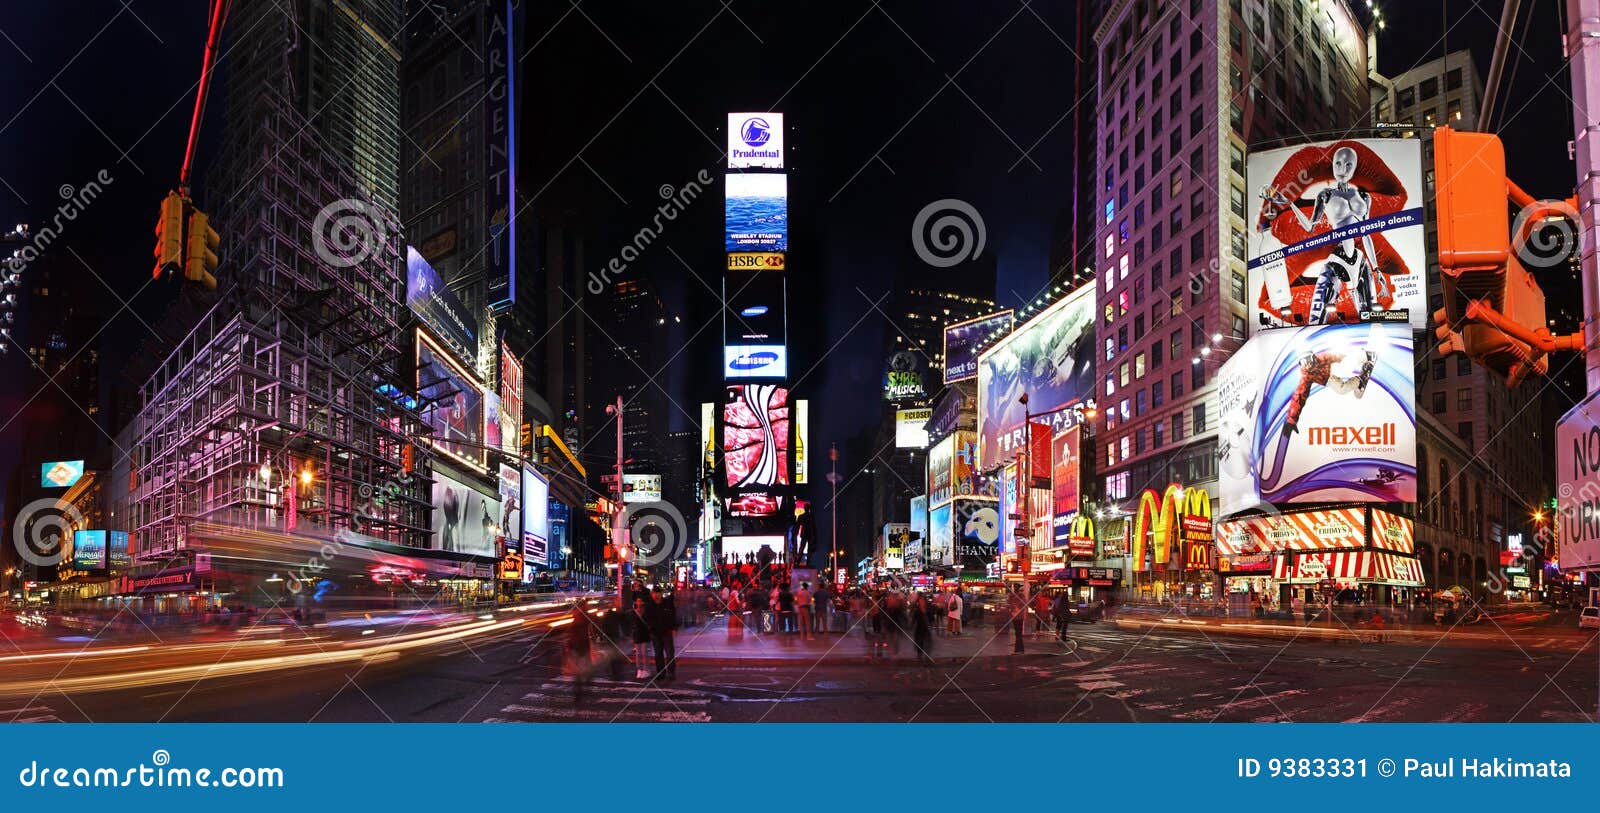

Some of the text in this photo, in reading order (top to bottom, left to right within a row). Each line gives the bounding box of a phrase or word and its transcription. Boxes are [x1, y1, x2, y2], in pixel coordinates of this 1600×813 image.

[733, 149, 780, 158] Prudential
[1288, 244, 1304, 254] man
[1306, 234, 1331, 248] cannot
[1332, 230, 1347, 241] live
[1360, 220, 1386, 234] gossip
[1387, 215, 1414, 226] alone.
[728, 255, 764, 267] HSBC
[946, 363, 965, 376] next
[966, 362, 976, 371] to
[888, 384, 925, 396] MUSICAL
[1308, 423, 1395, 445] maxell
[1184, 518, 1212, 528] McDonald's
[1270, 531, 1295, 539] FRIDAY'S
[1318, 527, 1347, 535] FRIDAY'S
[74, 551, 105, 560] MERMAID
